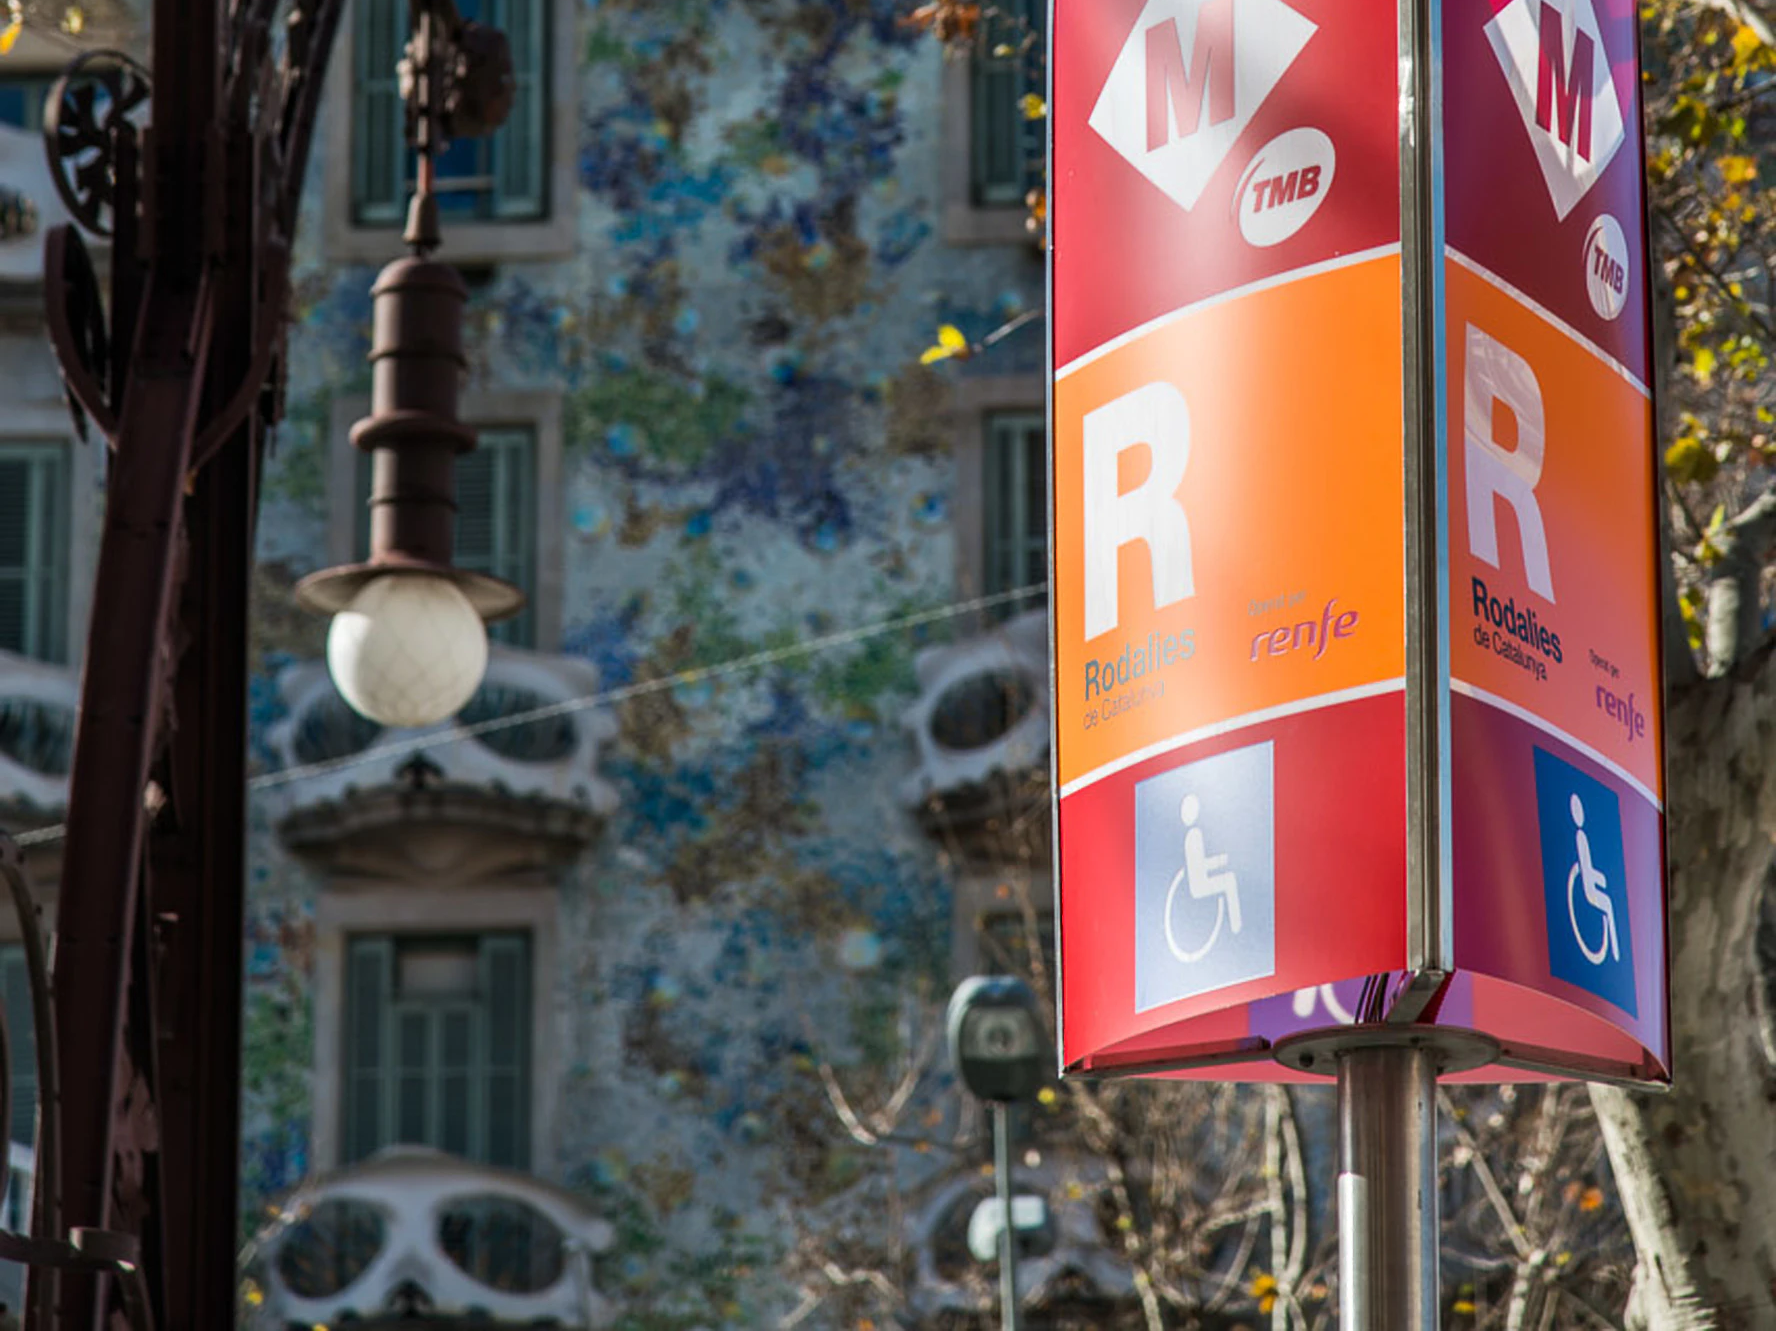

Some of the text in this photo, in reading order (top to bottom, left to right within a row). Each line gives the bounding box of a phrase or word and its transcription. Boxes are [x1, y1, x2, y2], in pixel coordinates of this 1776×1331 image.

[1536, 0, 1594, 163] M
[1253, 165, 1322, 213] TMB
[1594, 244, 1625, 295] TMB
[1464, 321, 1555, 604] R
[1083, 381, 1195, 642] R
[1250, 598, 1358, 662] renfe
[1472, 575, 1562, 664] Rodalies
[1474, 624, 1490, 650] de
[1493, 631, 1547, 681] Catalunya
[1085, 629, 1195, 701] Rodalies
[1596, 685, 1644, 742] renfe
